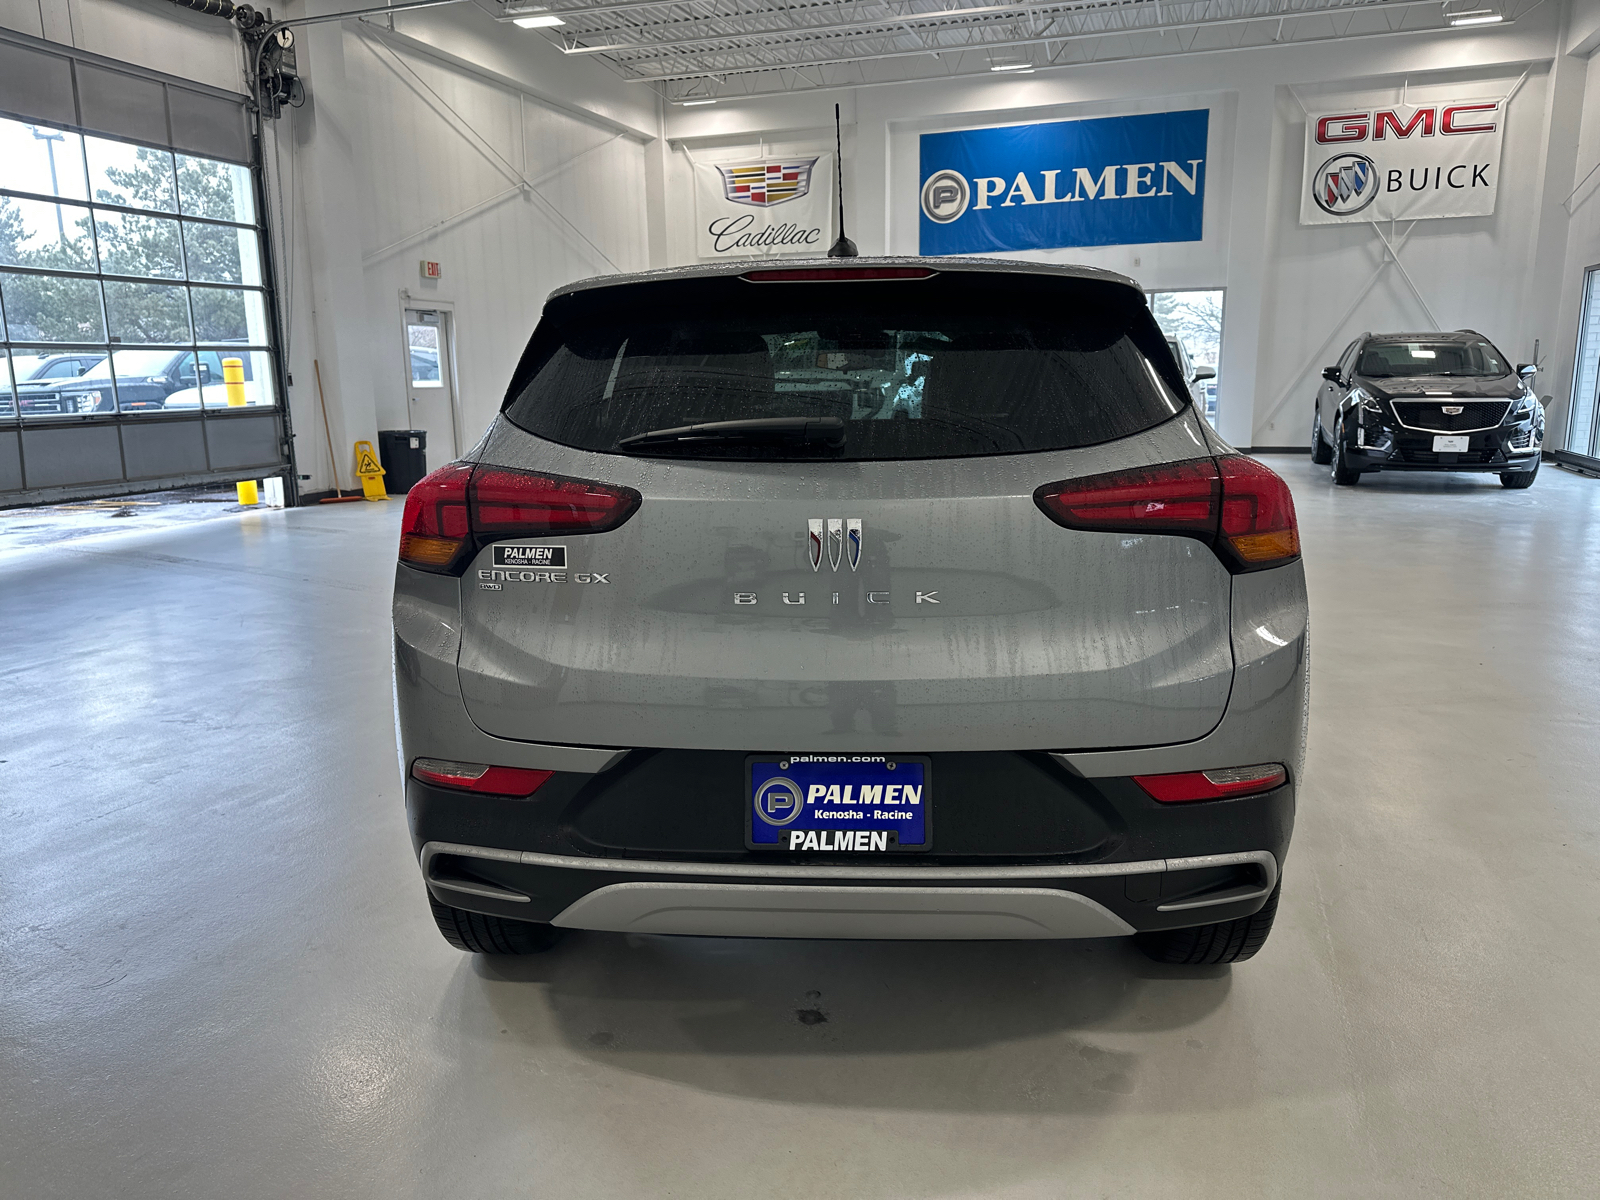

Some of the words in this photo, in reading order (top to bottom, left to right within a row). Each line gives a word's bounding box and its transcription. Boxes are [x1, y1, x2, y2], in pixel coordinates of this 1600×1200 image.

[1314, 102, 1499, 145] GMC
[972, 159, 1203, 211] PALMEN
[1387, 163, 1490, 193] BUICK
[708, 214, 821, 253] Cadillac
[427, 261, 439, 276] EXIT
[504, 548, 553, 559] PALMEN
[478, 570, 567, 583] ENCORE
[574, 573, 611, 584] GX
[734, 591, 941, 605] BUICK
[790, 755, 886, 763] palmen.com
[767, 792, 794, 812] P
[806, 784, 922, 805] PALMEN
[814, 809, 864, 819] Kenosha
[873, 810, 913, 820] Racine
[789, 831, 888, 851] PALMEN
